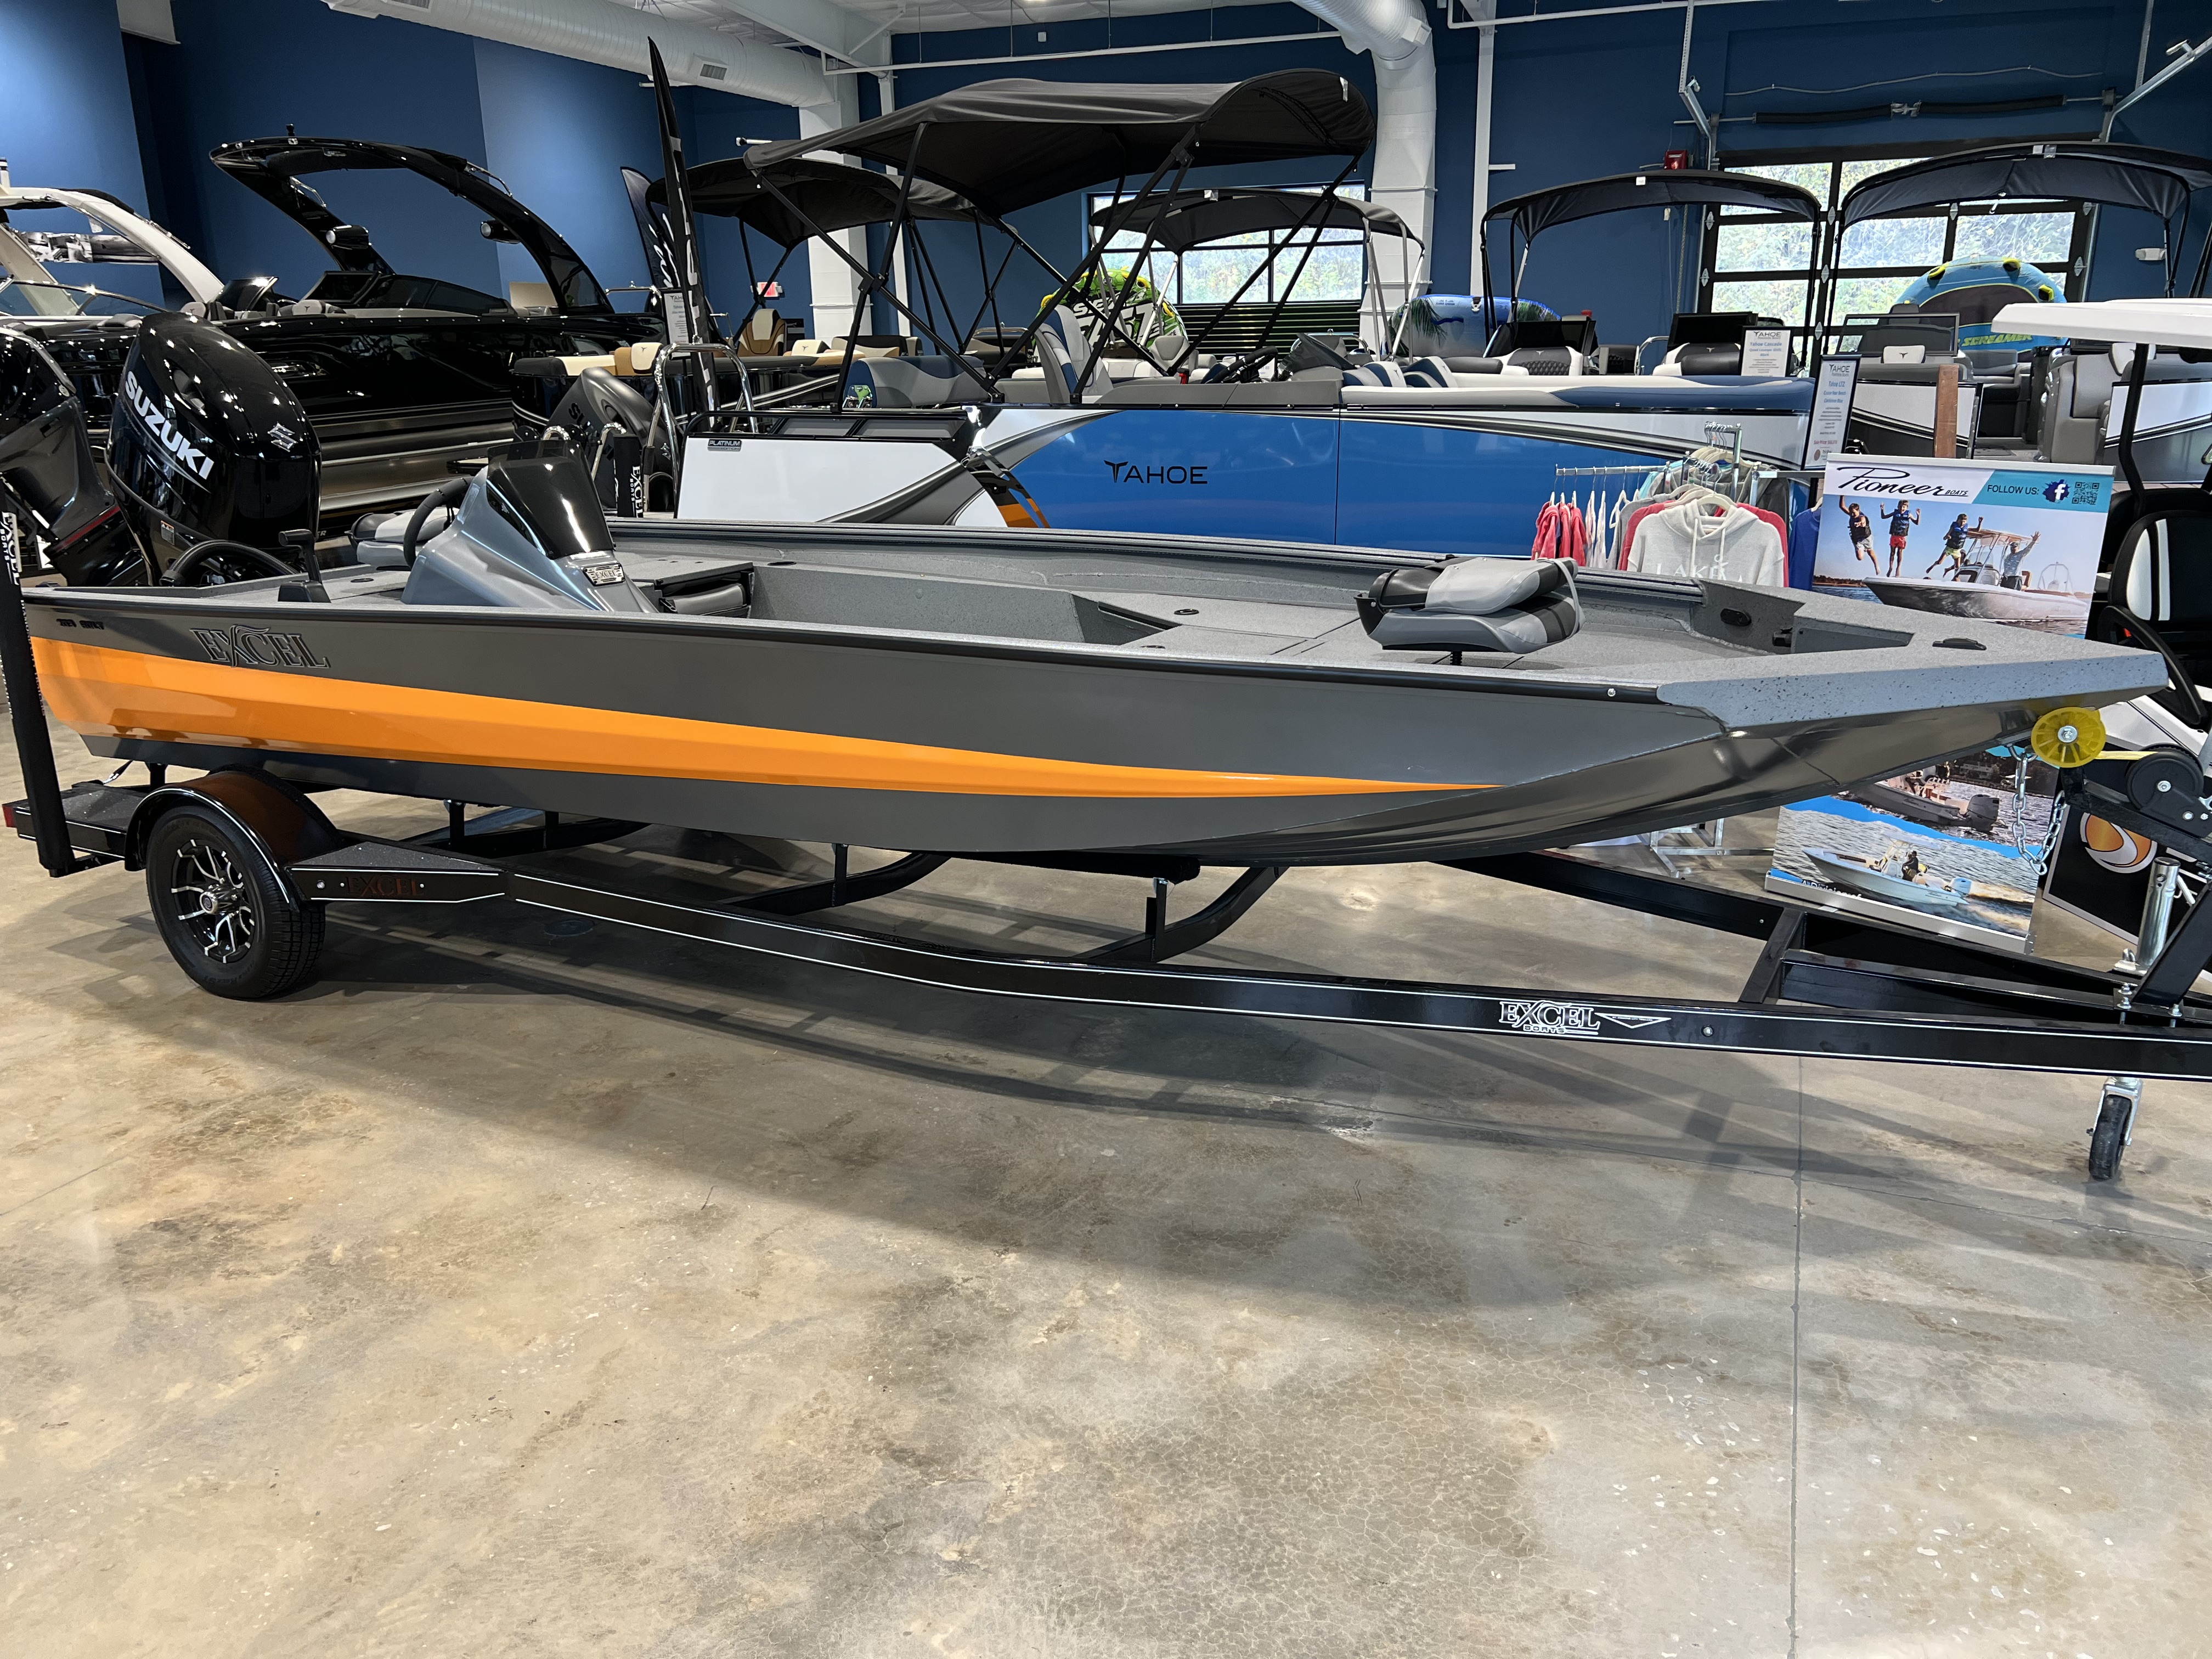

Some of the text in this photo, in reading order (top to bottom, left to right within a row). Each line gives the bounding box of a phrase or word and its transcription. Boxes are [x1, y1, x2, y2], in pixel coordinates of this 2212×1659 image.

[1829, 364, 1850, 373] TAHOE
[125, 370, 215, 480] SUZUKI
[1103, 460, 1208, 484] TAHOE
[1836, 466, 1945, 496] Pioneer
[630, 465, 643, 519] EXCEL
[1987, 484, 2023, 494] FOLLOW
[595, 570, 618, 579] EXCEL
[189, 623, 332, 669] EXCEL
[346, 874, 424, 896] EXCEL
[1499, 1000, 1601, 1030] EXCEL
[1523, 1024, 1566, 1034] BOATS
